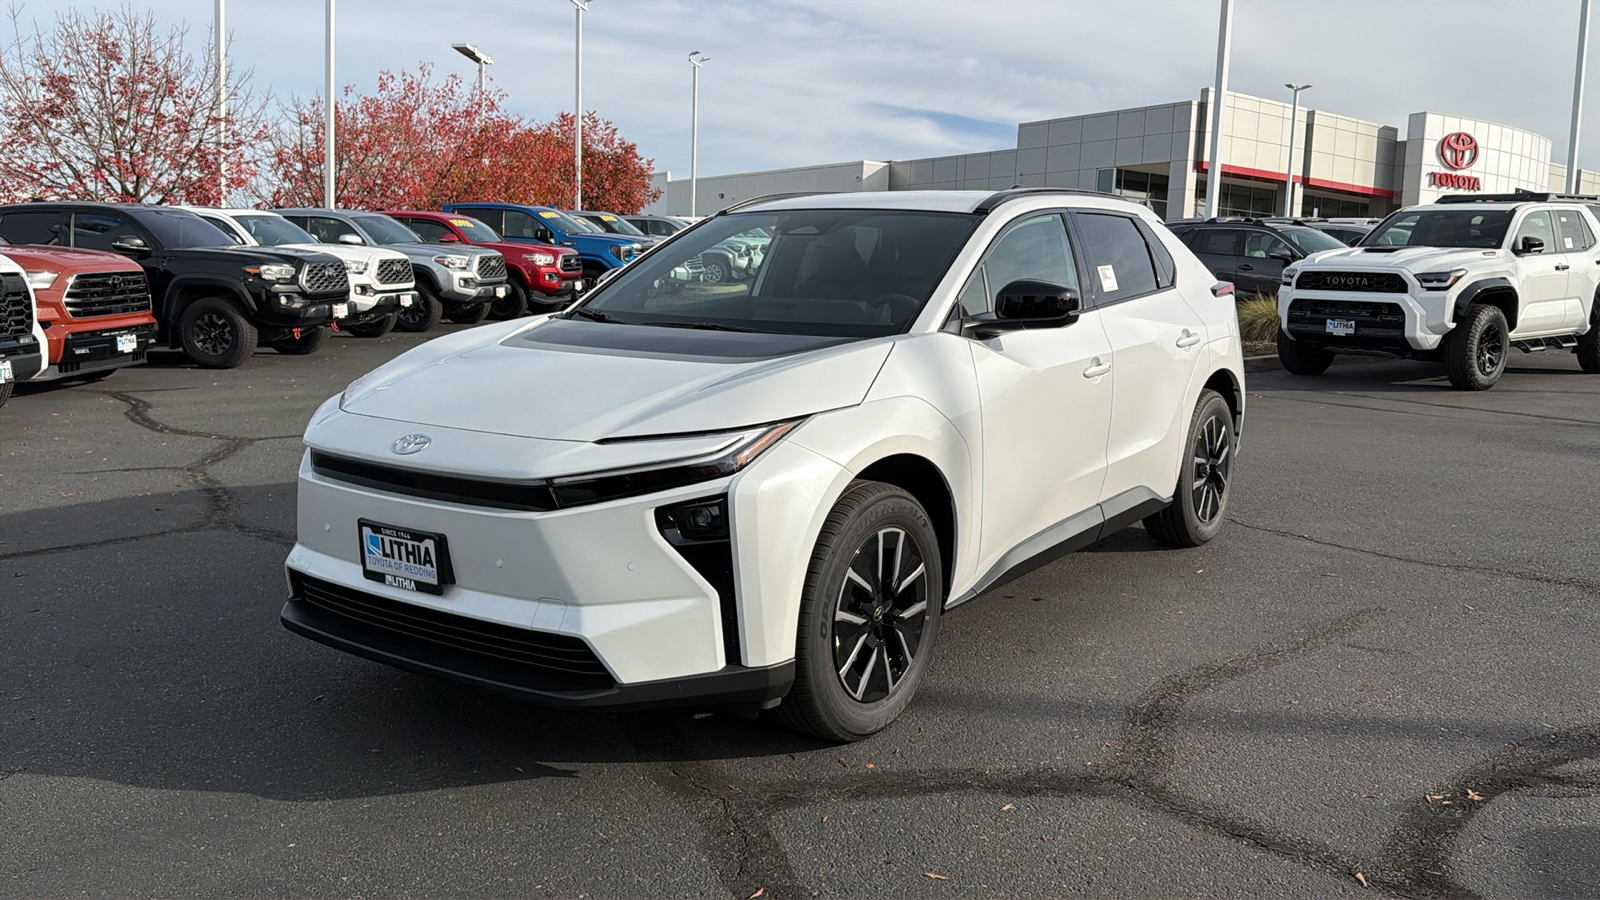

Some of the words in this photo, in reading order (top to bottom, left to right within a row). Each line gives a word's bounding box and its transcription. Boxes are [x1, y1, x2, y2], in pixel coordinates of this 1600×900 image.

[1431, 171, 1481, 191] TOYOTA
[1326, 276, 1369, 286] TOYOTA
[1333, 321, 1354, 330] LITHIA
[381, 528, 397, 537] SINCE
[398, 532, 411, 540] 1946
[380, 537, 434, 569] LITHIA
[368, 556, 393, 569] TOYOTA
[394, 562, 402, 571] OF
[405, 564, 436, 579] REDDING
[392, 576, 416, 591] LITHIA
